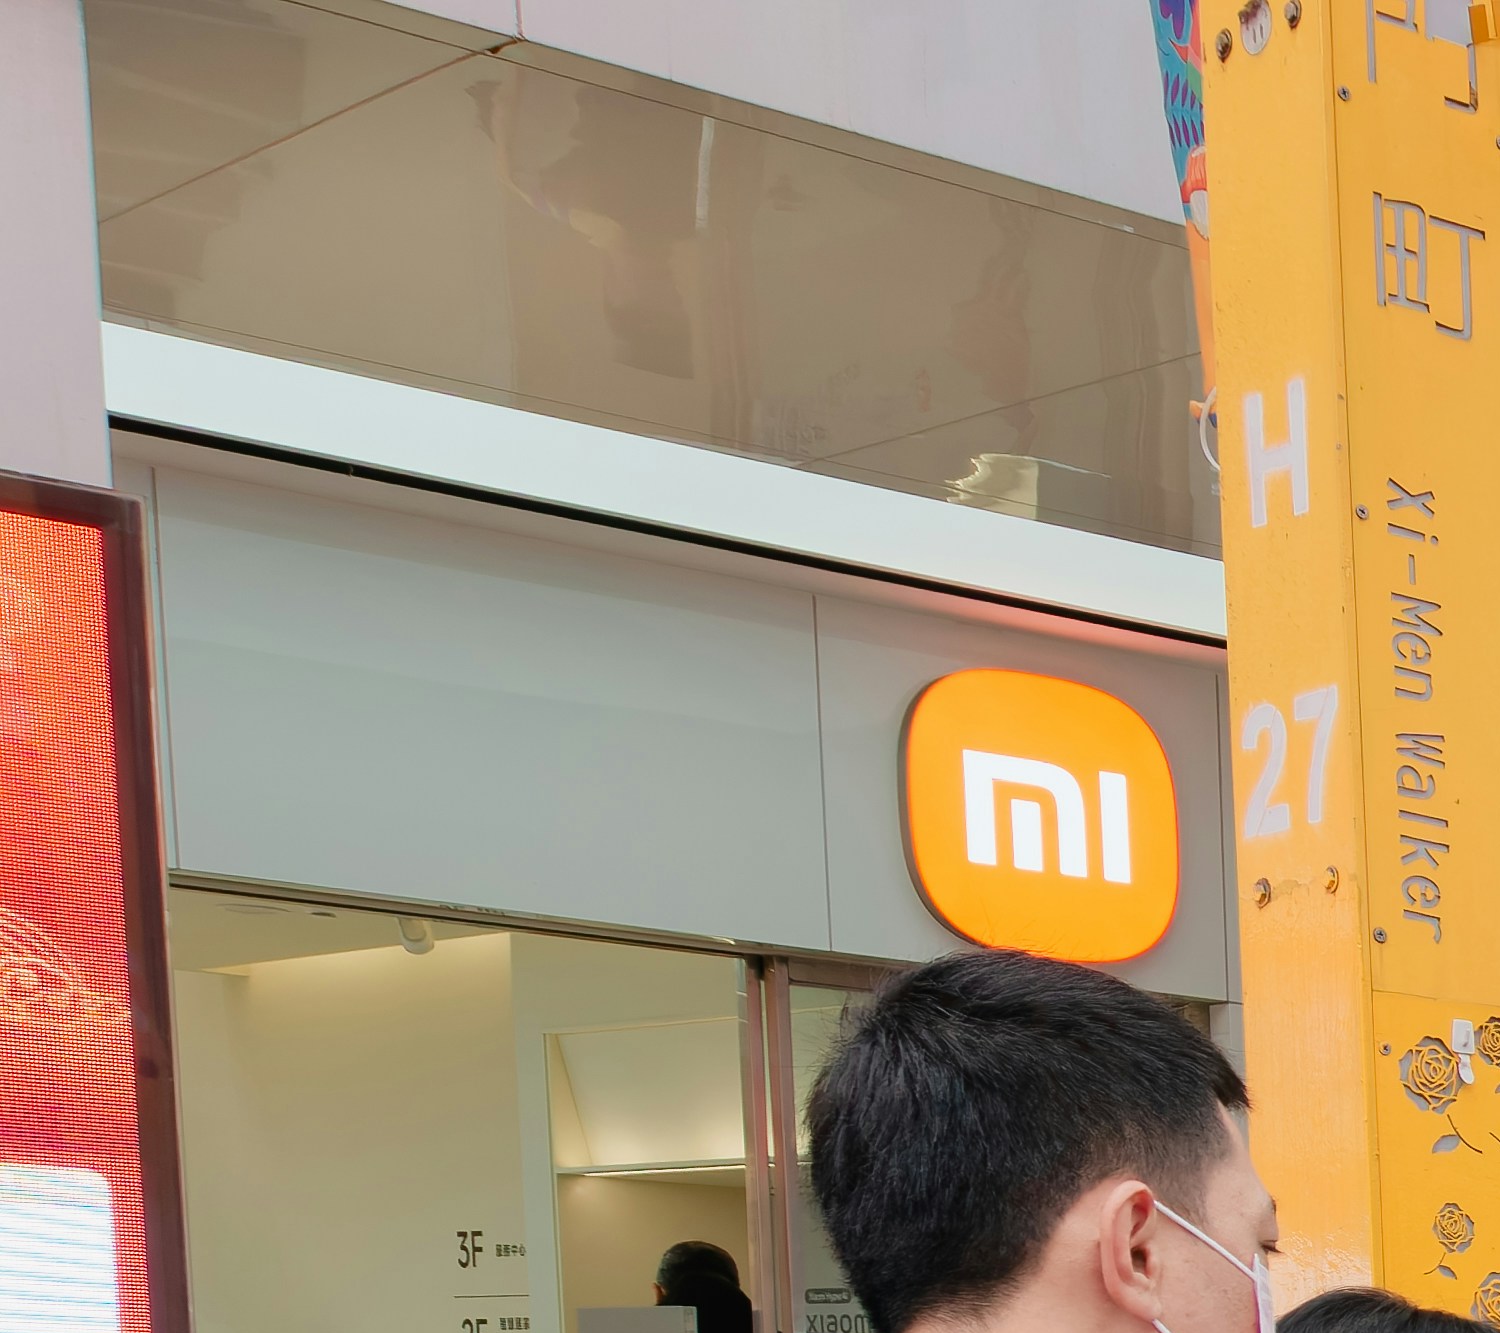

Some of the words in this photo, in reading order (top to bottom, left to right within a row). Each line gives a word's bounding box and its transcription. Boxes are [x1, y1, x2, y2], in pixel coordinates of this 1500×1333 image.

[1241, 378, 1309, 528] H
[1385, 476, 1446, 703] Xi-Men
[1241, 686, 1340, 841] 27
[1392, 731, 1449, 944] Walker
[456, 1230, 484, 1269] 3F
